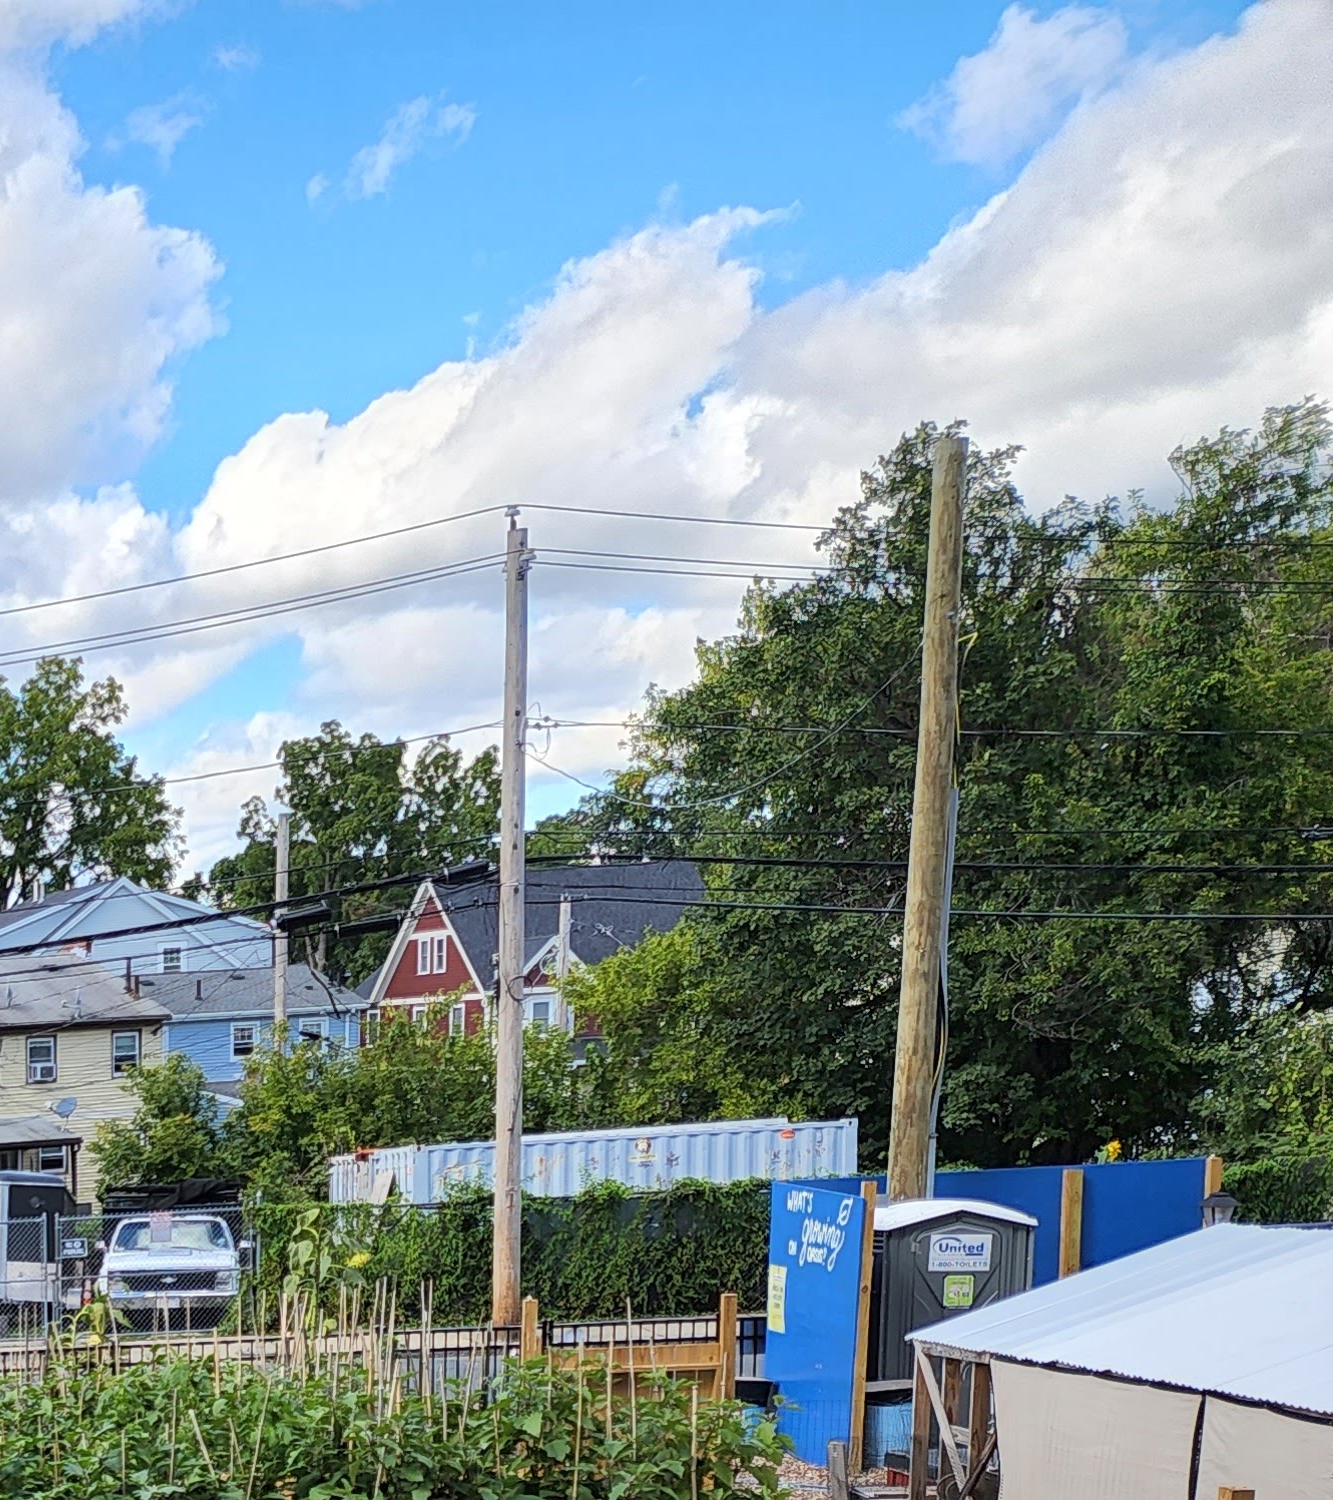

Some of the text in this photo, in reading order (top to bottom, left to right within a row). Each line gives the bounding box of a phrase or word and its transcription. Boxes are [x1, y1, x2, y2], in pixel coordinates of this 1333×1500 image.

[787, 1190, 813, 1213] WHAT'S
[799, 1216, 845, 1272] growing
[938, 1242, 984, 1253] United
